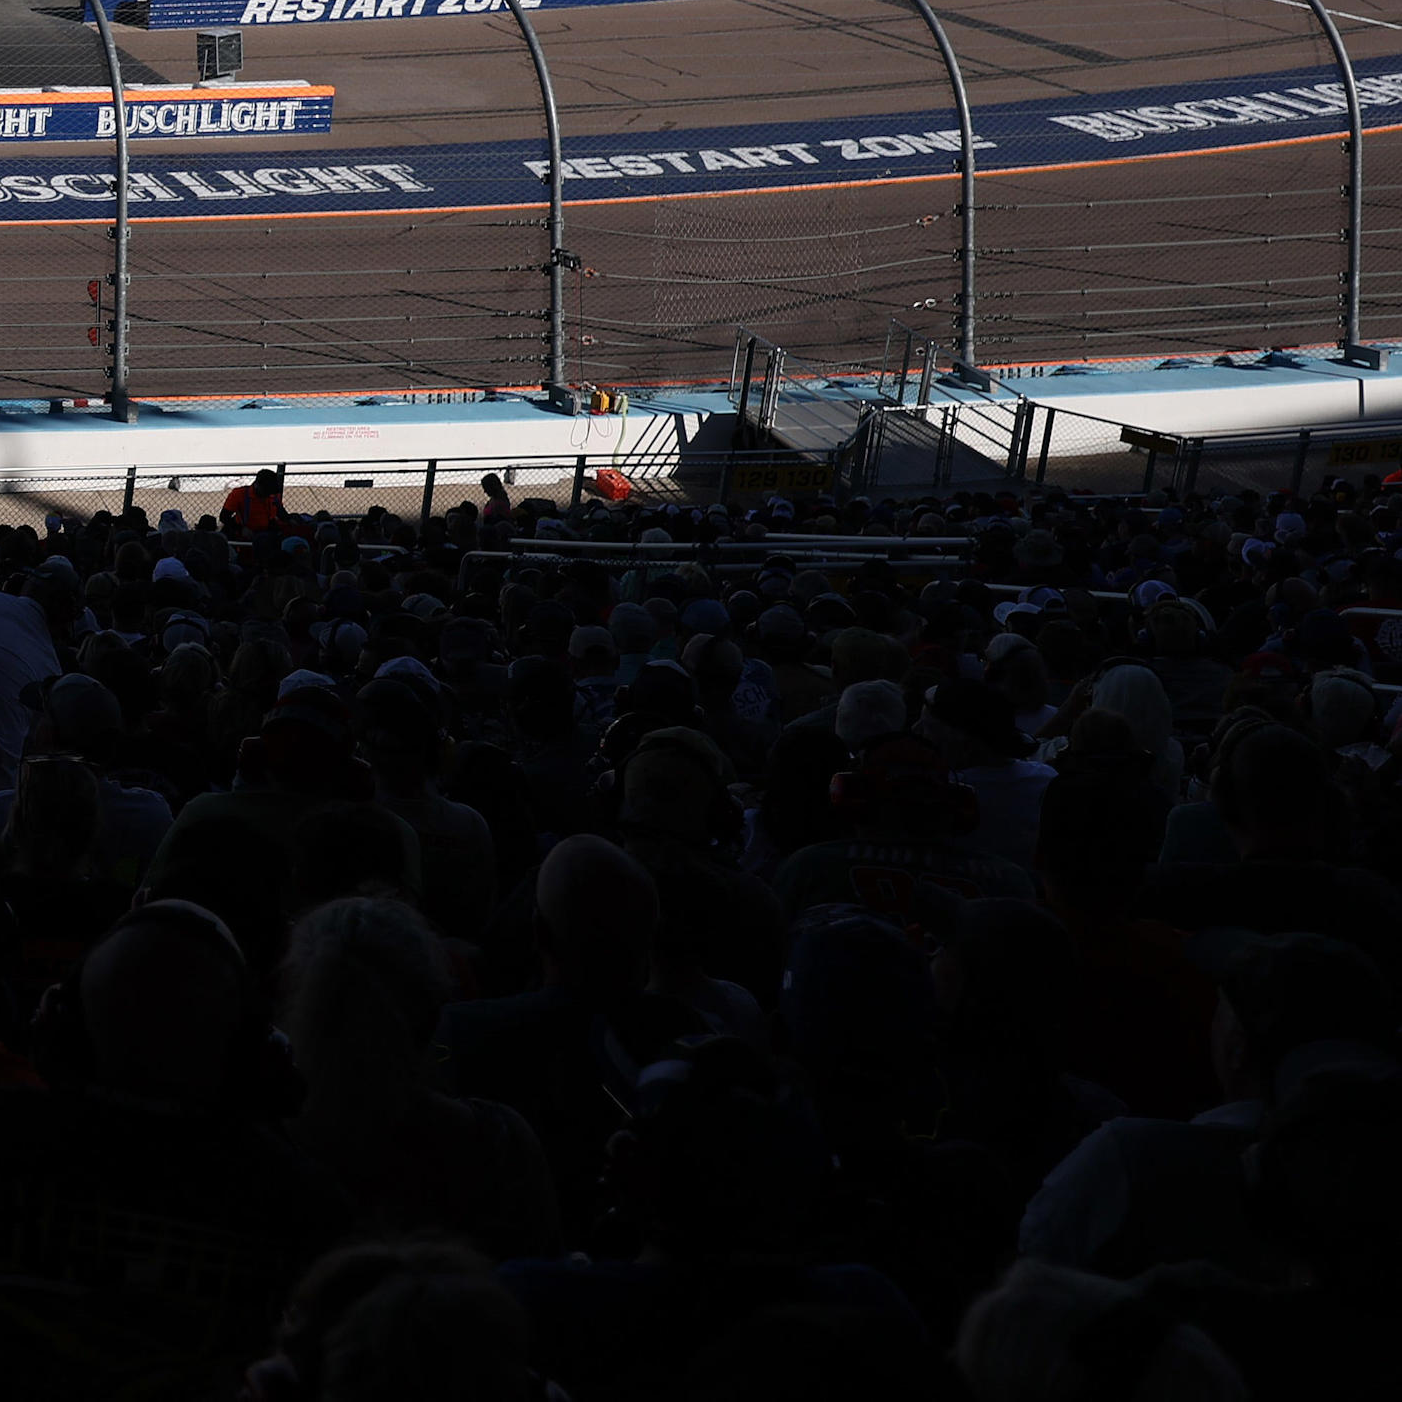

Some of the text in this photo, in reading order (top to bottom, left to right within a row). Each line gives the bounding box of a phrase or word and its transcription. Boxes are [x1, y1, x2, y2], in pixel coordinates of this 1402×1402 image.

[172, 162, 435, 201] LIGHT
[523, 143, 821, 181] RESTART
[819, 129, 998, 161] ZONE
[1334, 444, 1370, 463] 130
[739, 469, 827, 487] 129 130
